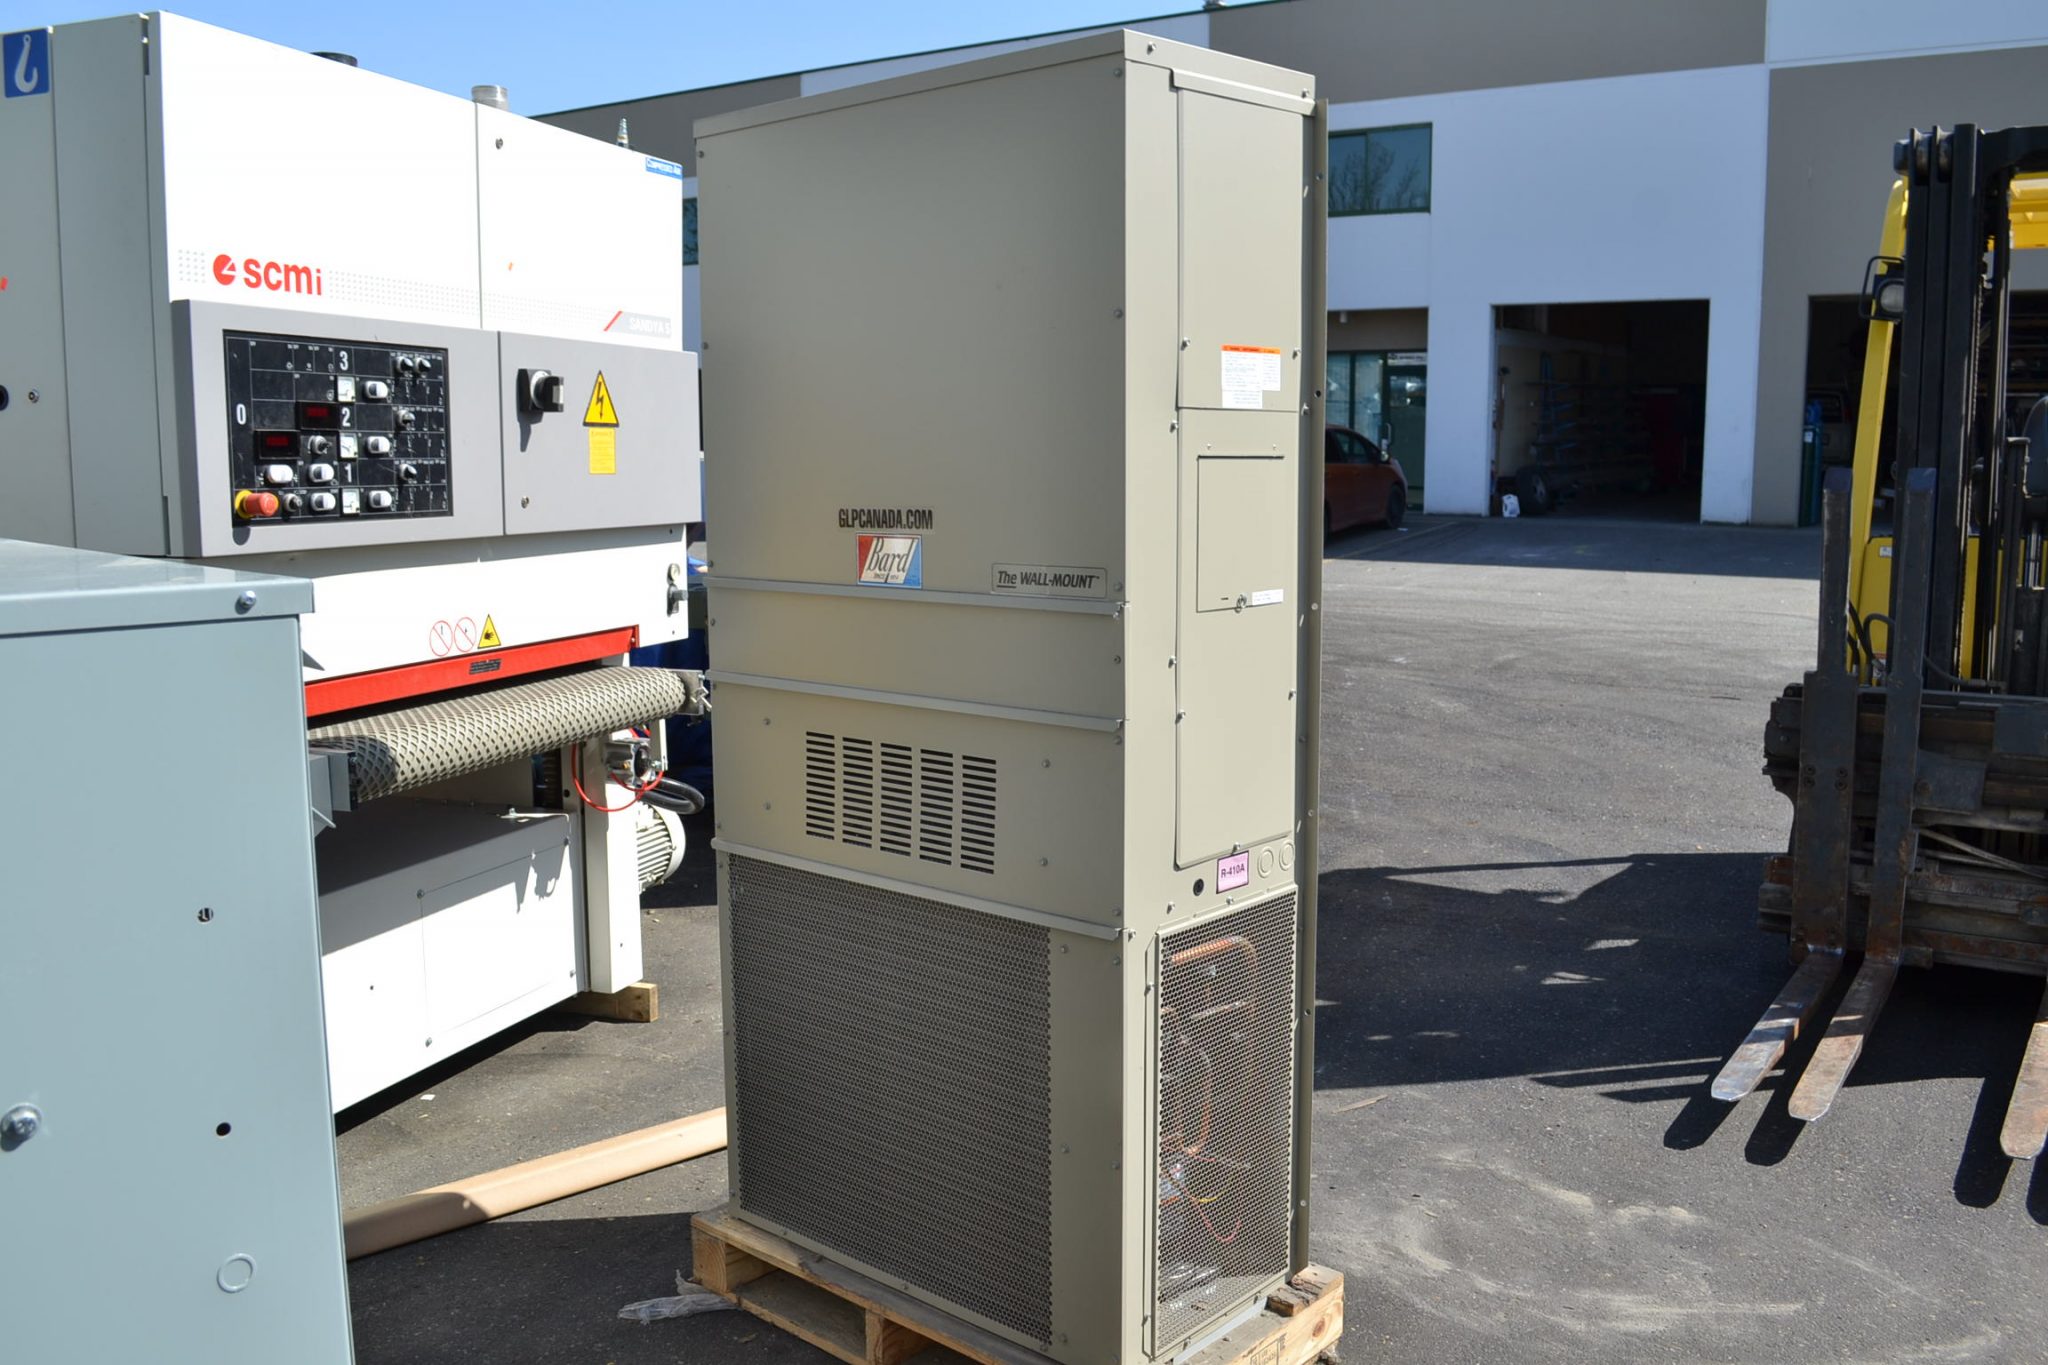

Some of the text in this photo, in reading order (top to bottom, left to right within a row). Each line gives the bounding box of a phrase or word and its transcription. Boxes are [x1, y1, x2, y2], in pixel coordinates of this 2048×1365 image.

[243, 258, 322, 296] scmi
[339, 350, 349, 371] 3
[236, 403, 246, 425] 0
[341, 407, 351, 427] 2
[344, 463, 352, 483] 1
[838, 508, 933, 530] GLPCANADA.COM
[866, 536, 914, 574] Bard
[998, 570, 1017, 588] The
[1220, 863, 1245, 878] R-410A
